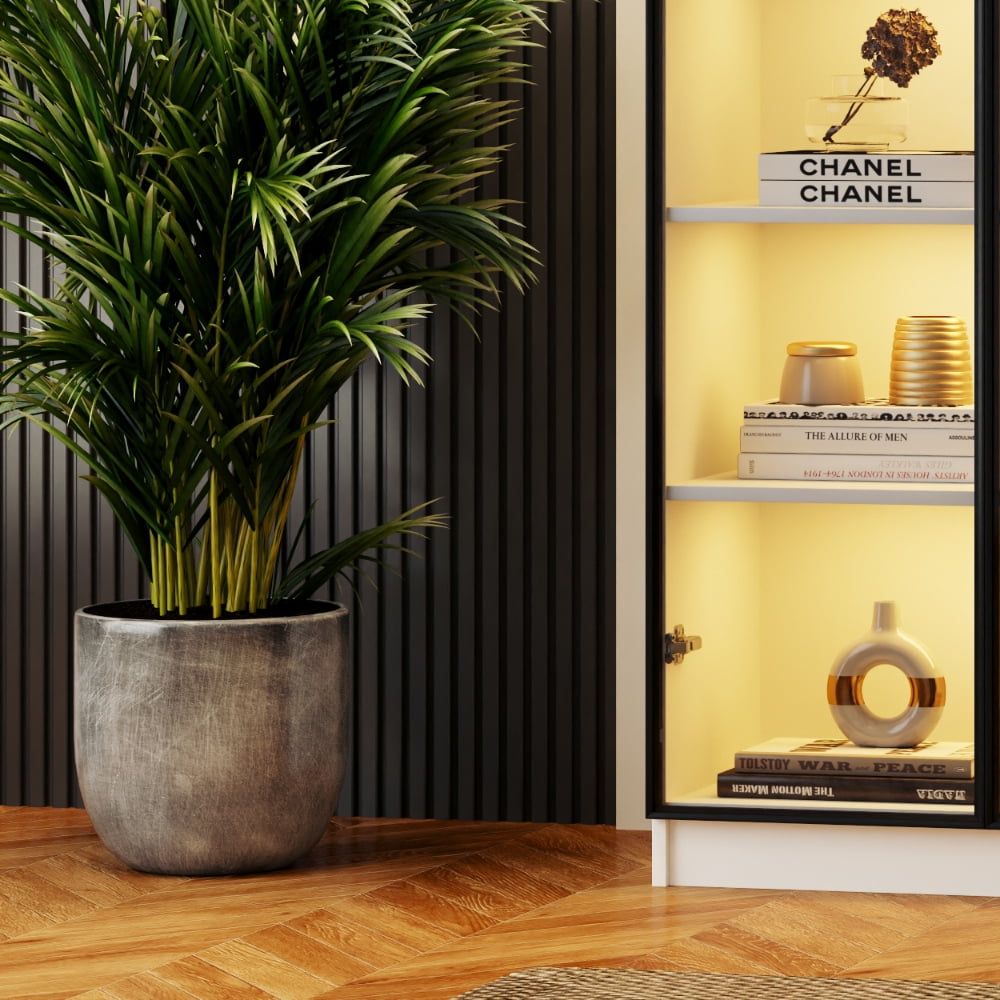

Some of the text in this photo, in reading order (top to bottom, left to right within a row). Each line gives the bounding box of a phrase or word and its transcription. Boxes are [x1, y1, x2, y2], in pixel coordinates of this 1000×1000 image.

[799, 158, 922, 177] CHANEL
[800, 185, 922, 203] CHANEL
[804, 431, 908, 441] THE ALLURE OF MEN
[847, 470, 883, 479] LONDON
[886, 471, 895, 479] IN
[897, 471, 930, 479] HOUSES
[740, 757, 791, 770] TOLSTOY
[797, 760, 852, 771] WAR
[873, 762, 946, 774] PEACE
[814, 786, 835, 797] THE
